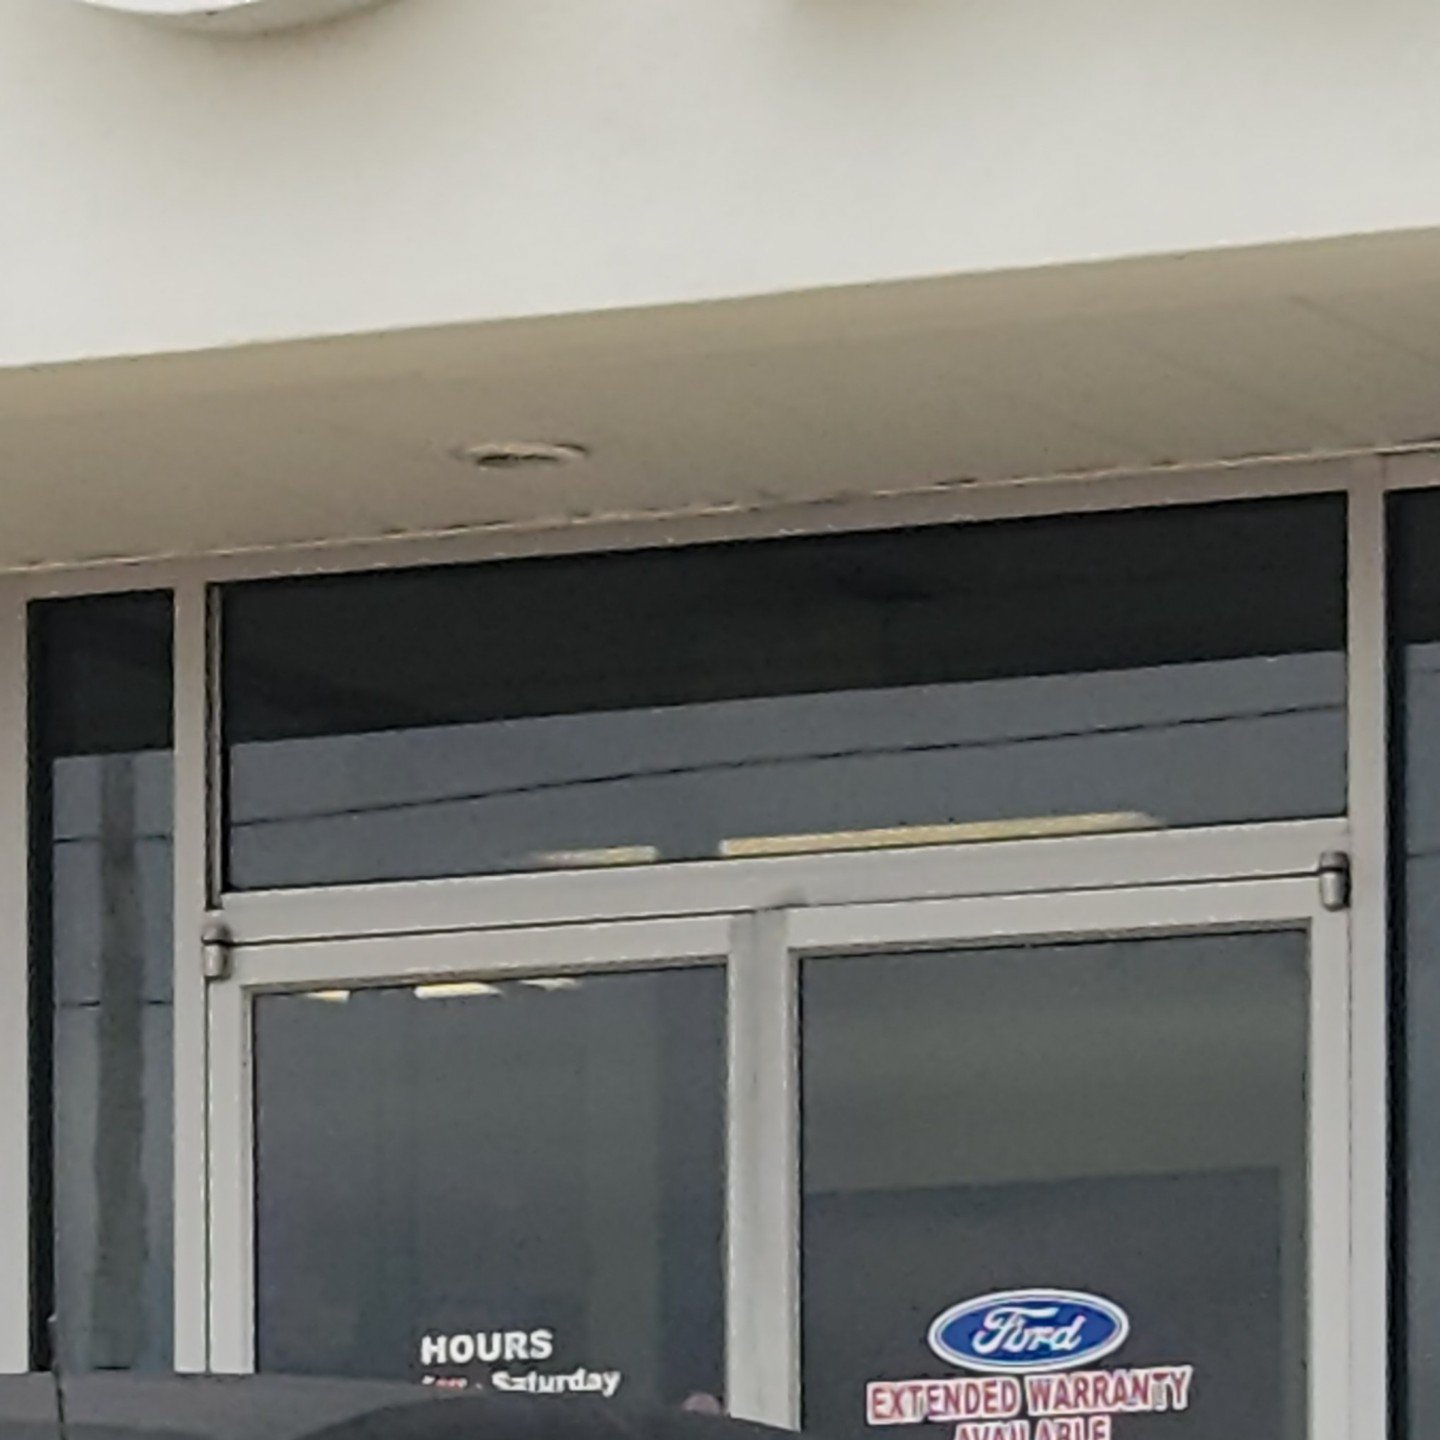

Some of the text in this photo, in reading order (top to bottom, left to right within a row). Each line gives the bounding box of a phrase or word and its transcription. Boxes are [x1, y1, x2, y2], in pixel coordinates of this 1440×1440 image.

[421, 1329, 553, 1365] HOURS
[971, 1306, 1087, 1354] Ford
[491, 1368, 620, 1397] Saturday
[869, 1368, 1191, 1421] EXTENDED WARRANTY
